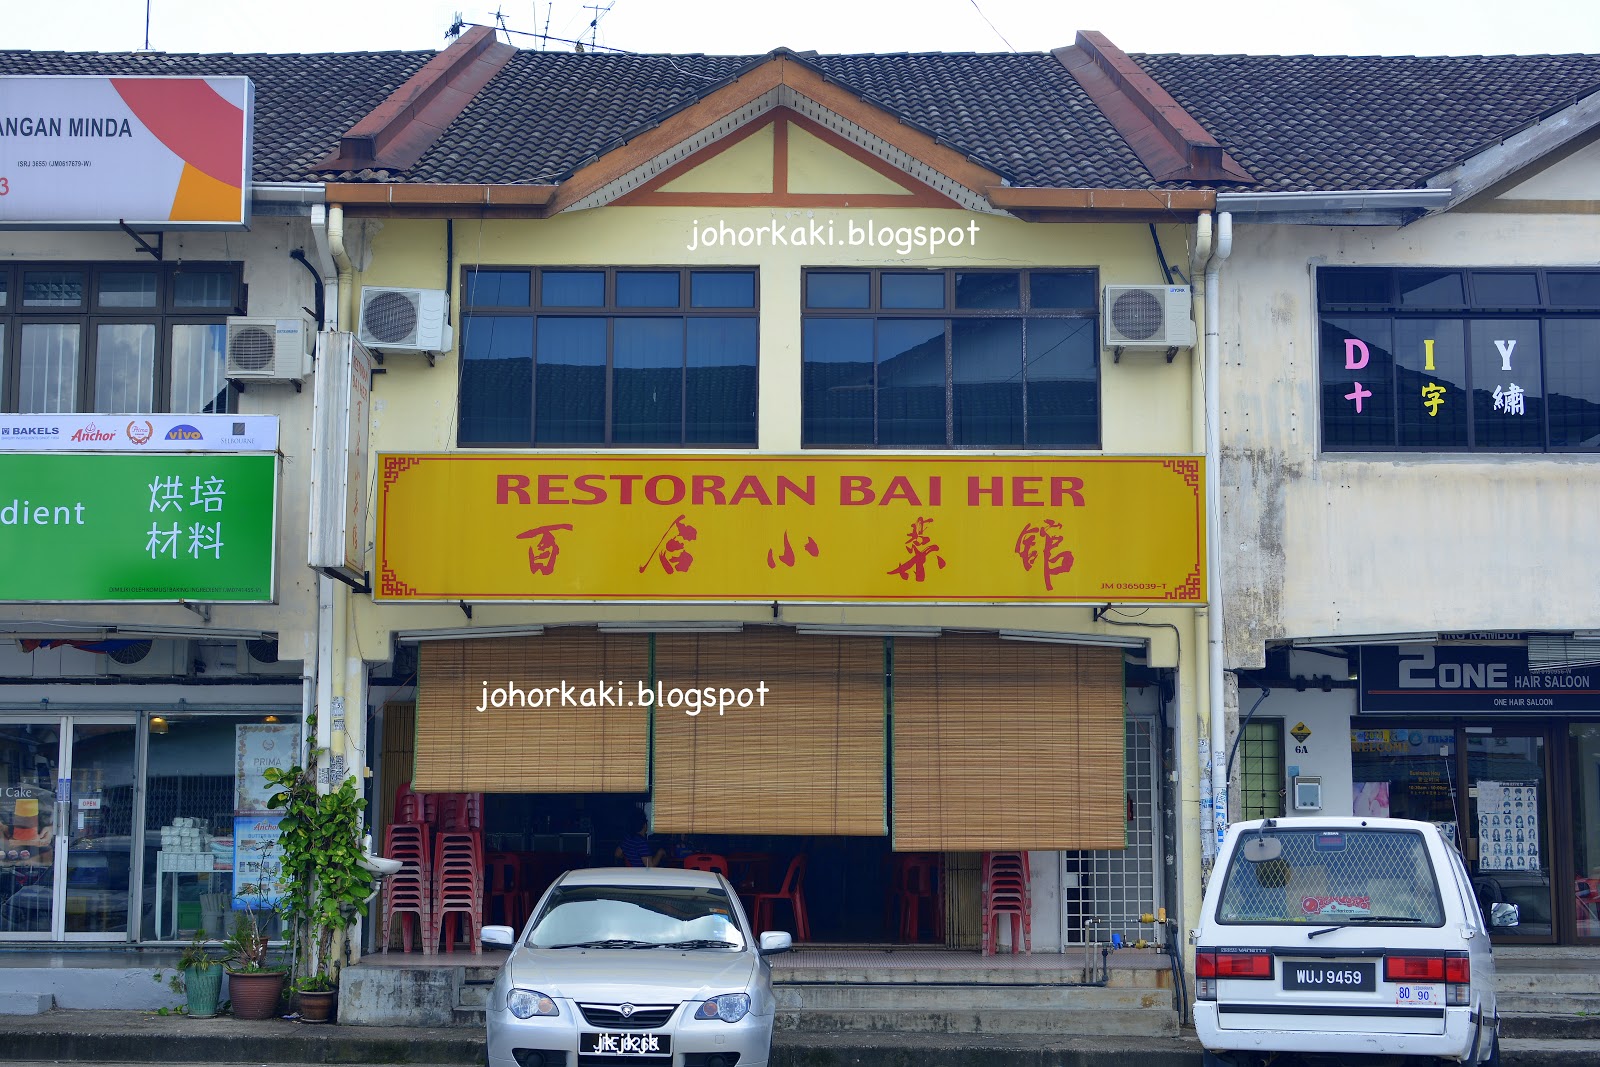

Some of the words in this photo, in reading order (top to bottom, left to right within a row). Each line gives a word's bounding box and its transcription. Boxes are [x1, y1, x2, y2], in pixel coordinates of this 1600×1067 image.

[69, 117, 132, 137] MINDA
[12, 427, 60, 435] BAKELS
[71, 428, 116, 442] Anchor
[169, 429, 201, 440] vivo
[496, 474, 815, 506] RESTORAN
[839, 475, 942, 506] BAI
[967, 476, 1086, 507] HER
[0, 499, 85, 525] dient
[146, 521, 225, 559] 材料
[1116, 582, 1168, 590] 0365039-T
[1514, 676, 1541, 688] HAIR
[1544, 676, 1590, 688] SALOON
[1295, 745, 1308, 754] 6A
[253, 757, 282, 766] PRIMA
[5, 787, 32, 798] Cake
[1296, 969, 1323, 984] WUJ
[1326, 970, 1362, 985] 9459
[1399, 986, 1410, 999] 80
[1417, 990, 1429, 1001] 90
